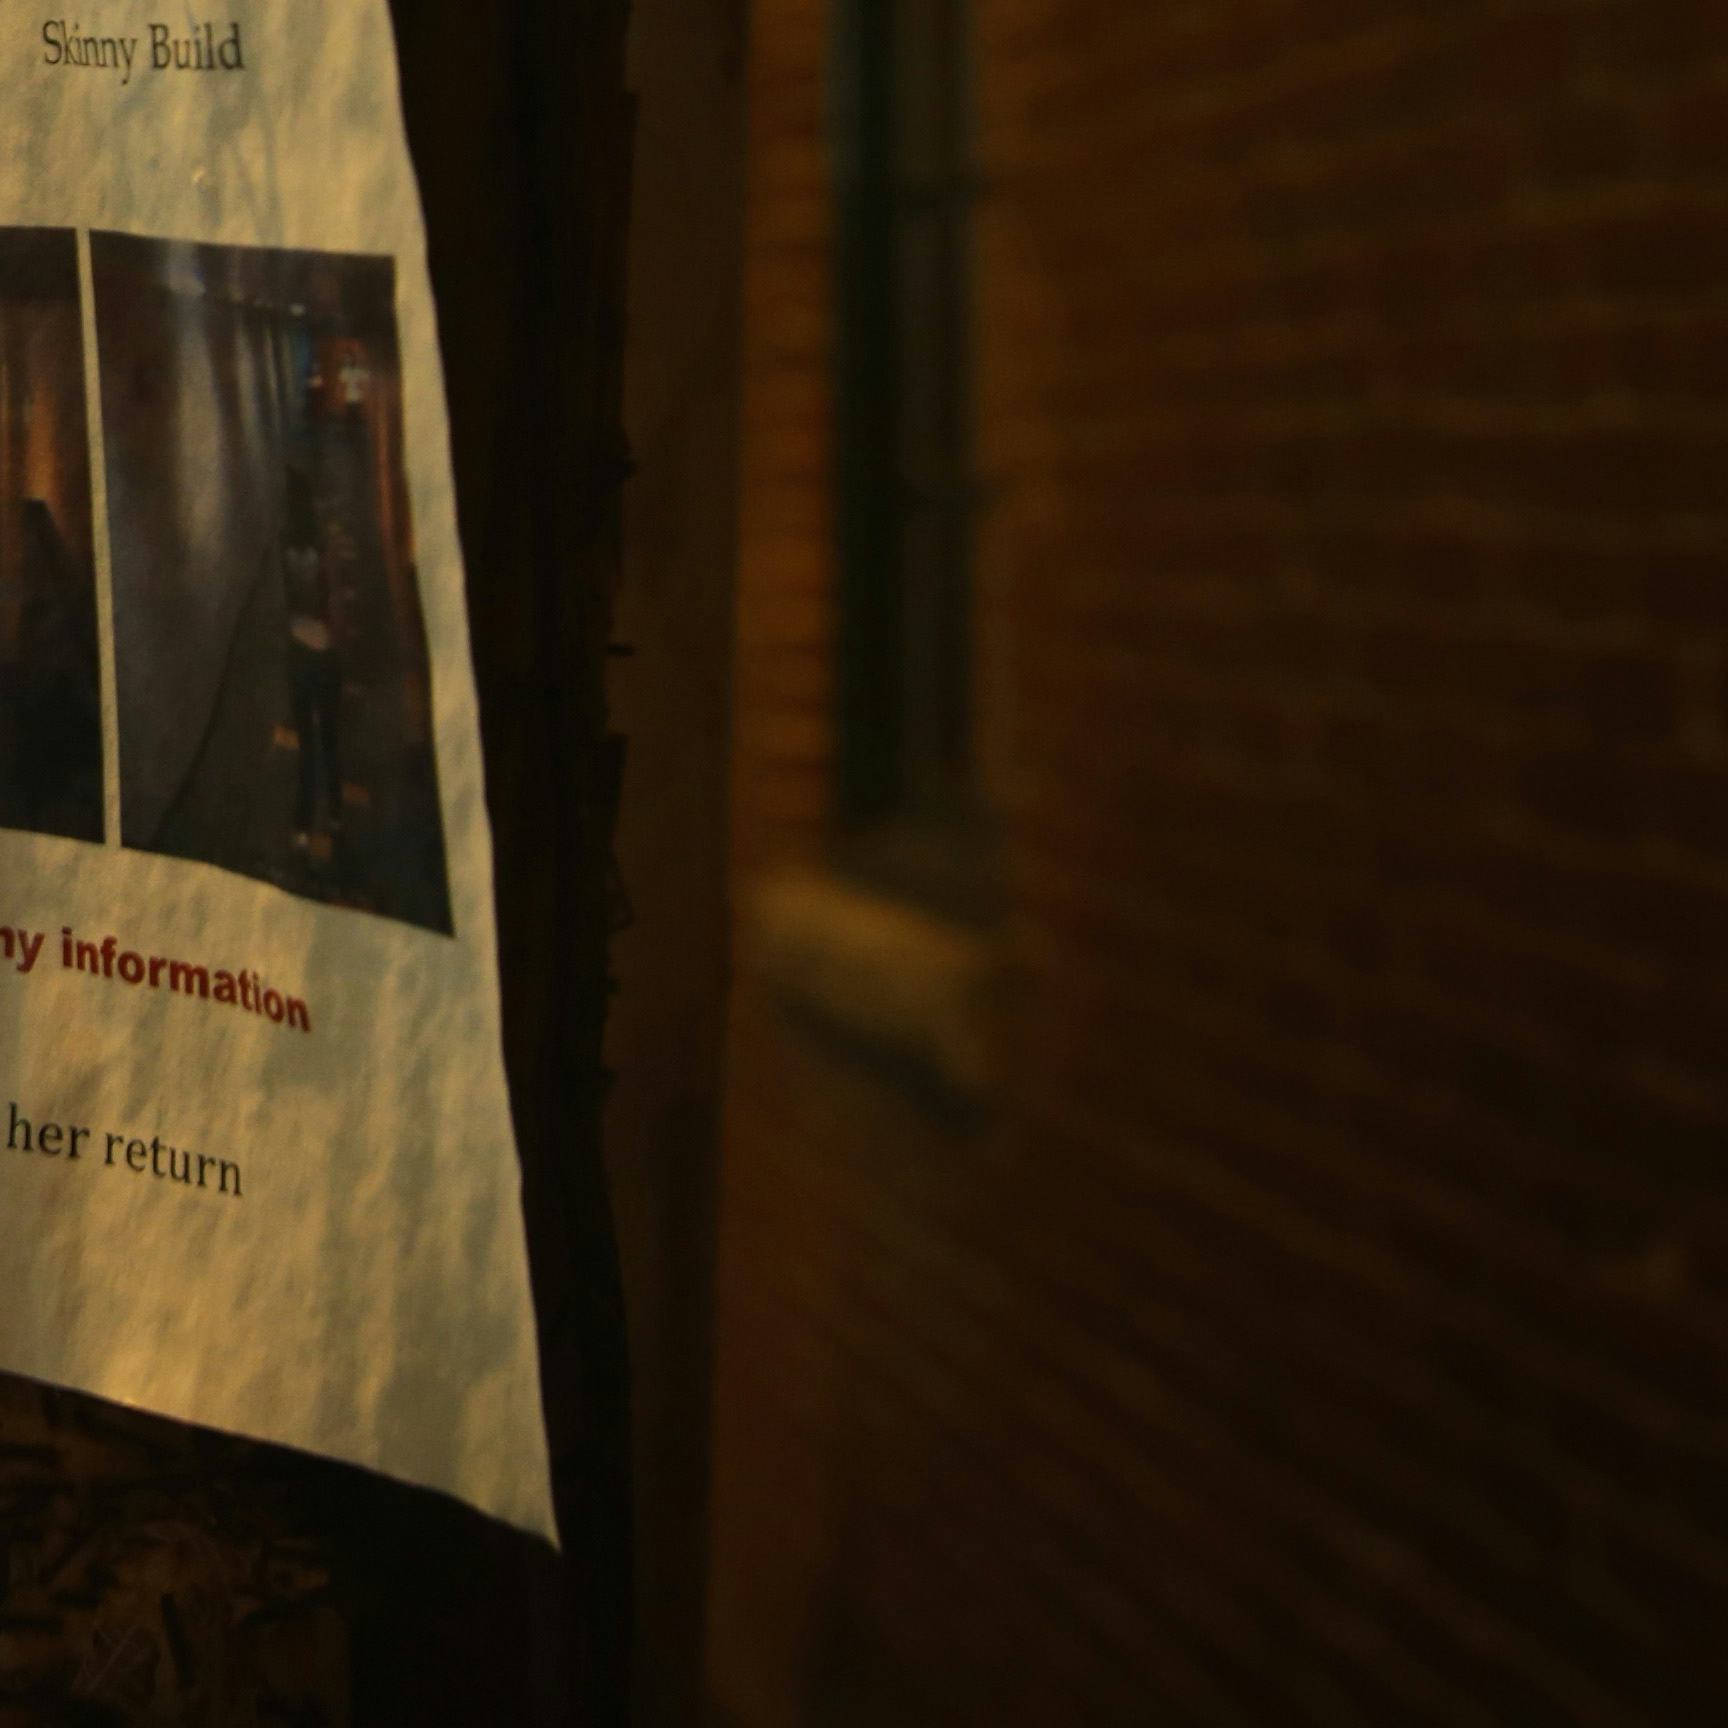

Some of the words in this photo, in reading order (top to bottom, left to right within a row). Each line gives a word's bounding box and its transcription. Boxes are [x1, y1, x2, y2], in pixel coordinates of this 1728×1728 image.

[43, 19, 137, 85] Skinny
[148, 23, 244, 70] Build
[61, 928, 312, 1032] information
[8, 1102, 90, 1160] her
[104, 1130, 244, 1197] return
